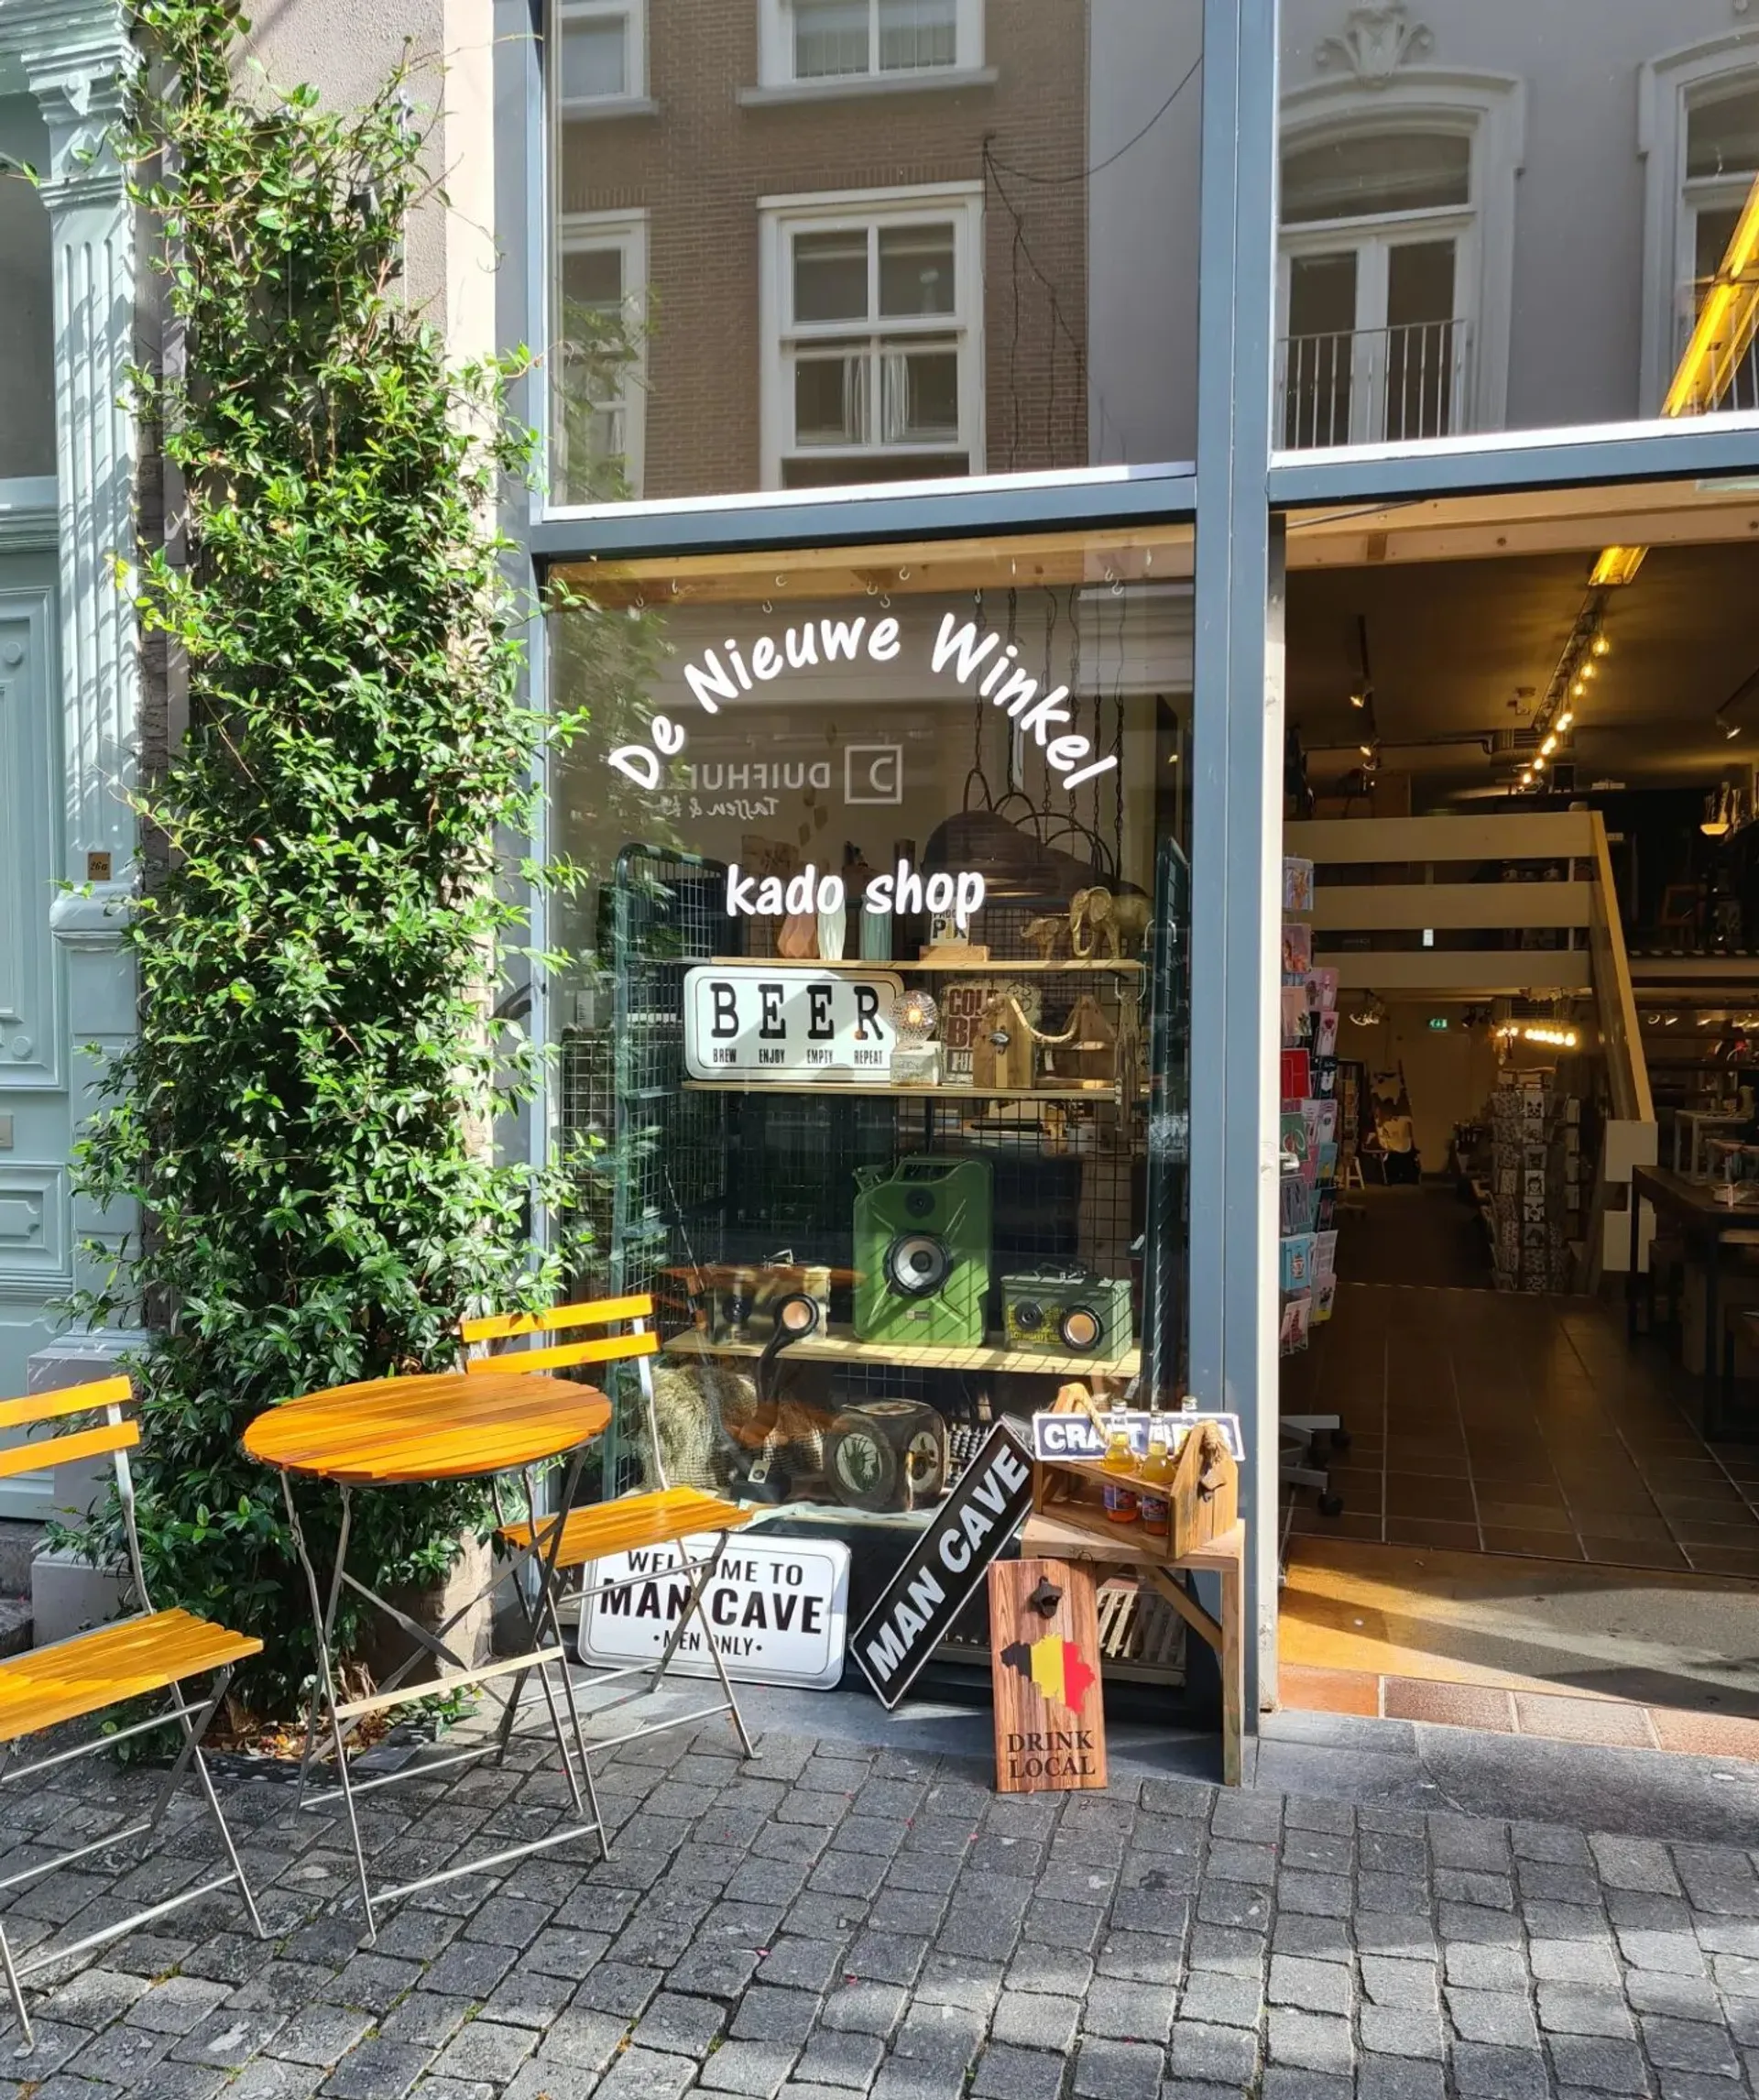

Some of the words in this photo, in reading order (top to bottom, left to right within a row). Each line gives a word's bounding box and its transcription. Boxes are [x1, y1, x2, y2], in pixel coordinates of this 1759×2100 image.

[607, 714, 685, 792] De
[683, 616, 901, 715] Nieuwe
[930, 611, 1119, 791] Winkel
[725, 862, 846, 917] kado
[866, 858, 986, 930] shop
[709, 982, 885, 1042] BEER
[949, 988, 1000, 1016] COL
[712, 1048, 737, 1064] BREW
[758, 1048, 785, 1065] ENJOY
[806, 1049, 834, 1065] EMPTY
[854, 1050, 883, 1066] REPEAT
[772, 1562, 803, 1587] TO
[865, 1574, 945, 1683] MAN
[938, 1444, 1030, 1573] CAVE
[599, 1577, 694, 1621] MAN
[712, 1587, 824, 1635] CAVE
[1007, 1730, 1095, 1753] DRINK
[1009, 1755, 1096, 1778] LOCAL
